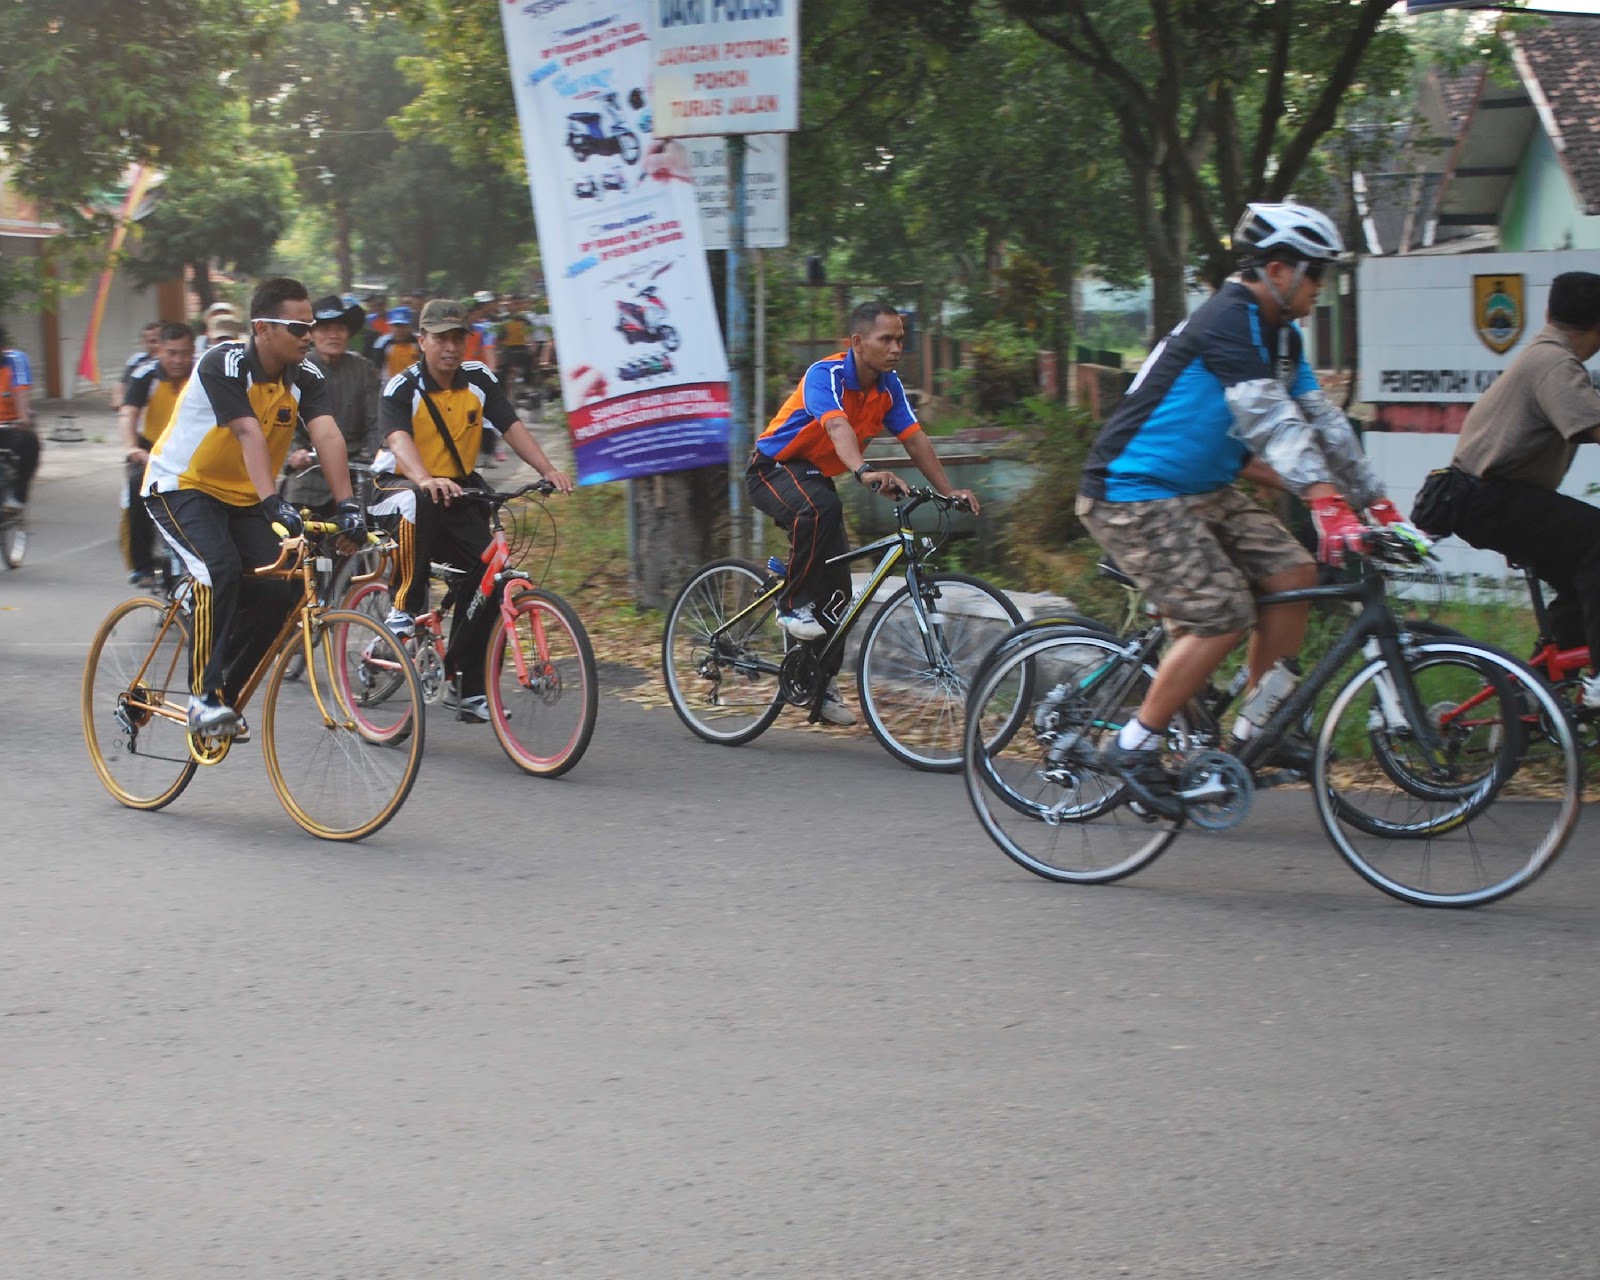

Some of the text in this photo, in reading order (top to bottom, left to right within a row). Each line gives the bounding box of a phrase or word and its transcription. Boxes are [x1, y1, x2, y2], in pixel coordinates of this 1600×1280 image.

[656, 43, 720, 67] JANGAN
[723, 37, 789, 60] POTONG
[694, 70, 748, 91] POHON
[671, 94, 779, 118] TURUS JALAN
